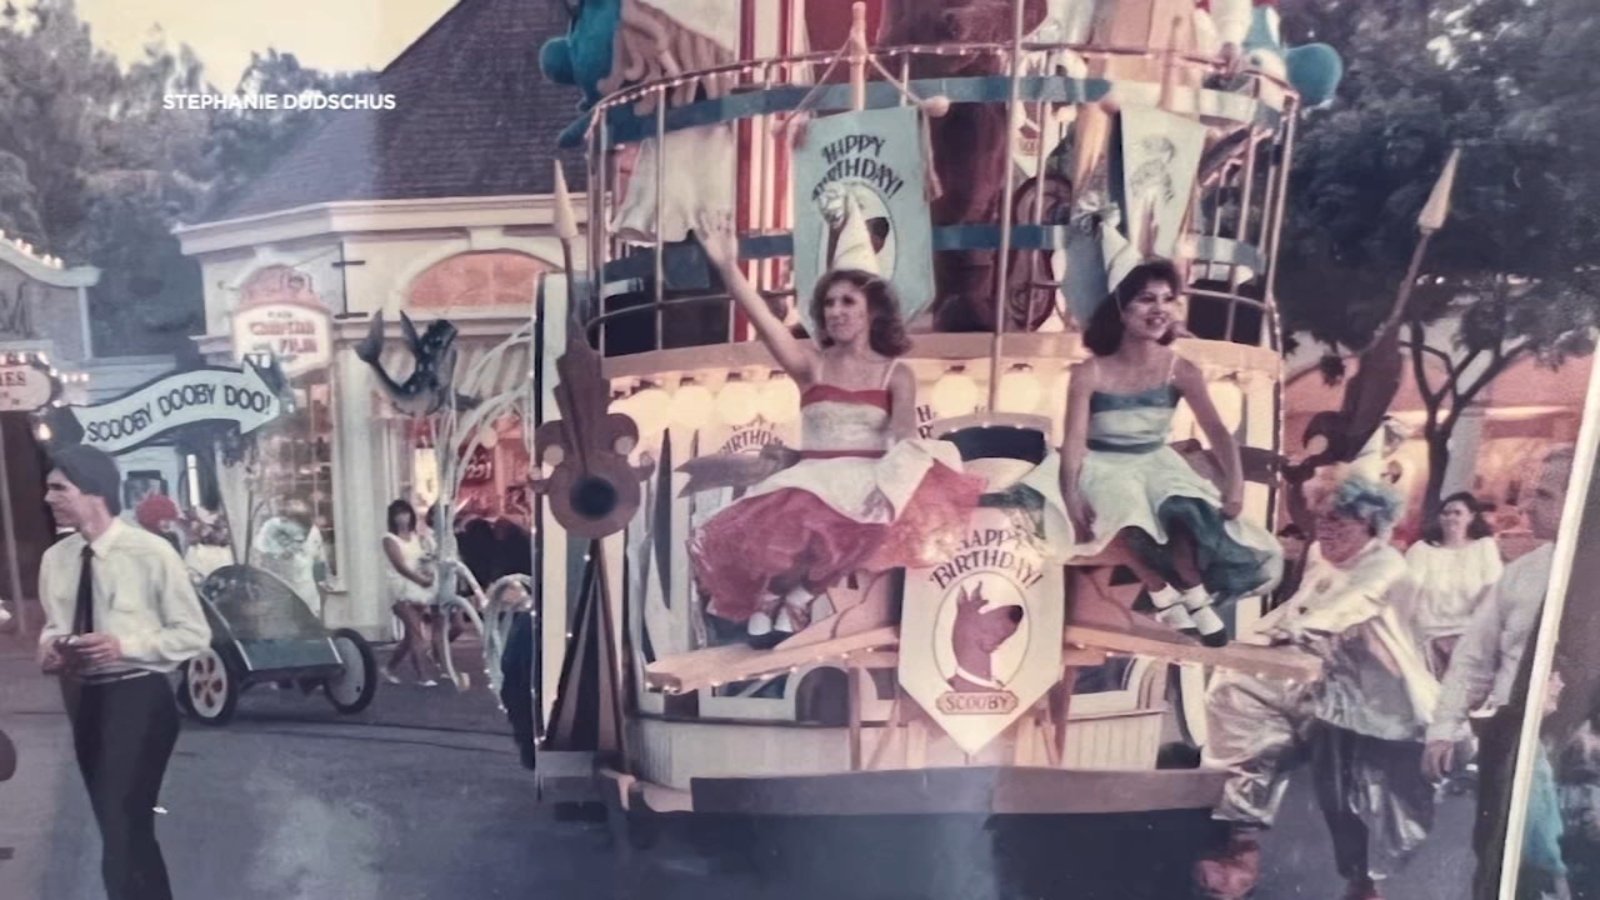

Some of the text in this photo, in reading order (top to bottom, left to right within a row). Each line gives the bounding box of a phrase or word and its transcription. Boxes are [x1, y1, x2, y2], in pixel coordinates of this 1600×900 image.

[87, 384, 271, 442] SCOOBY DOOBY DOO!
